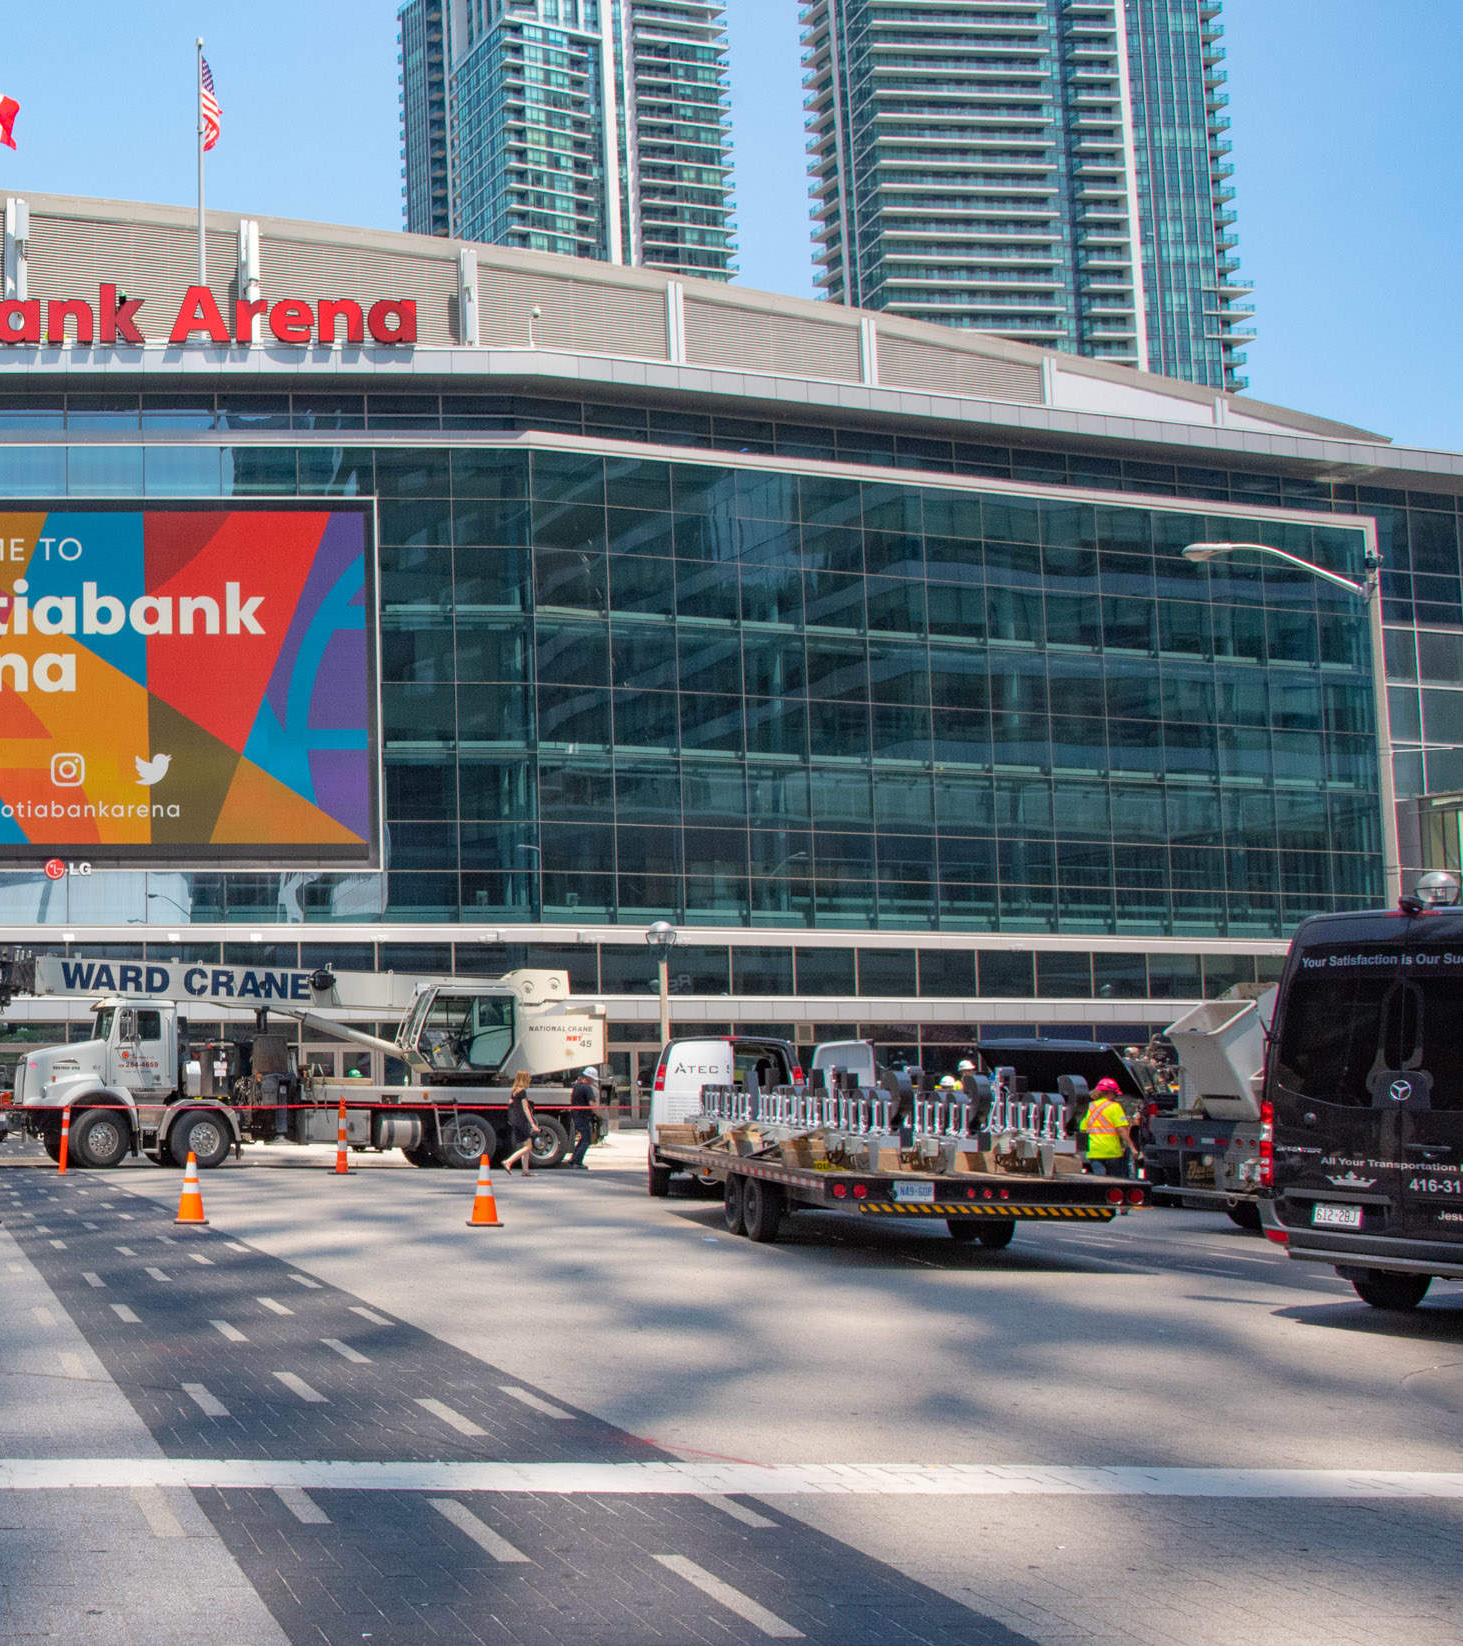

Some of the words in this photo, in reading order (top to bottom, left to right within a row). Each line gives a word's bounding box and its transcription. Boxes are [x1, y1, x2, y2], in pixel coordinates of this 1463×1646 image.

[169, 285, 418, 345] Arena
[39, 538, 83, 562] TO
[68, 862, 92, 876] LG
[1302, 957, 1327, 968] Your
[1328, 953, 1398, 967] Satisfaction
[1401, 953, 1413, 965] is
[1415, 953, 1441, 965] Our
[61, 962, 170, 993] WARD
[184, 967, 314, 1000] CRANE
[567, 1025, 593, 1033] CRANE
[579, 1040, 593, 1048] 45
[1321, 1156, 1336, 1165] All
[1338, 1157, 1366, 1167] Your
[1367, 1158, 1458, 1172] Transportation
